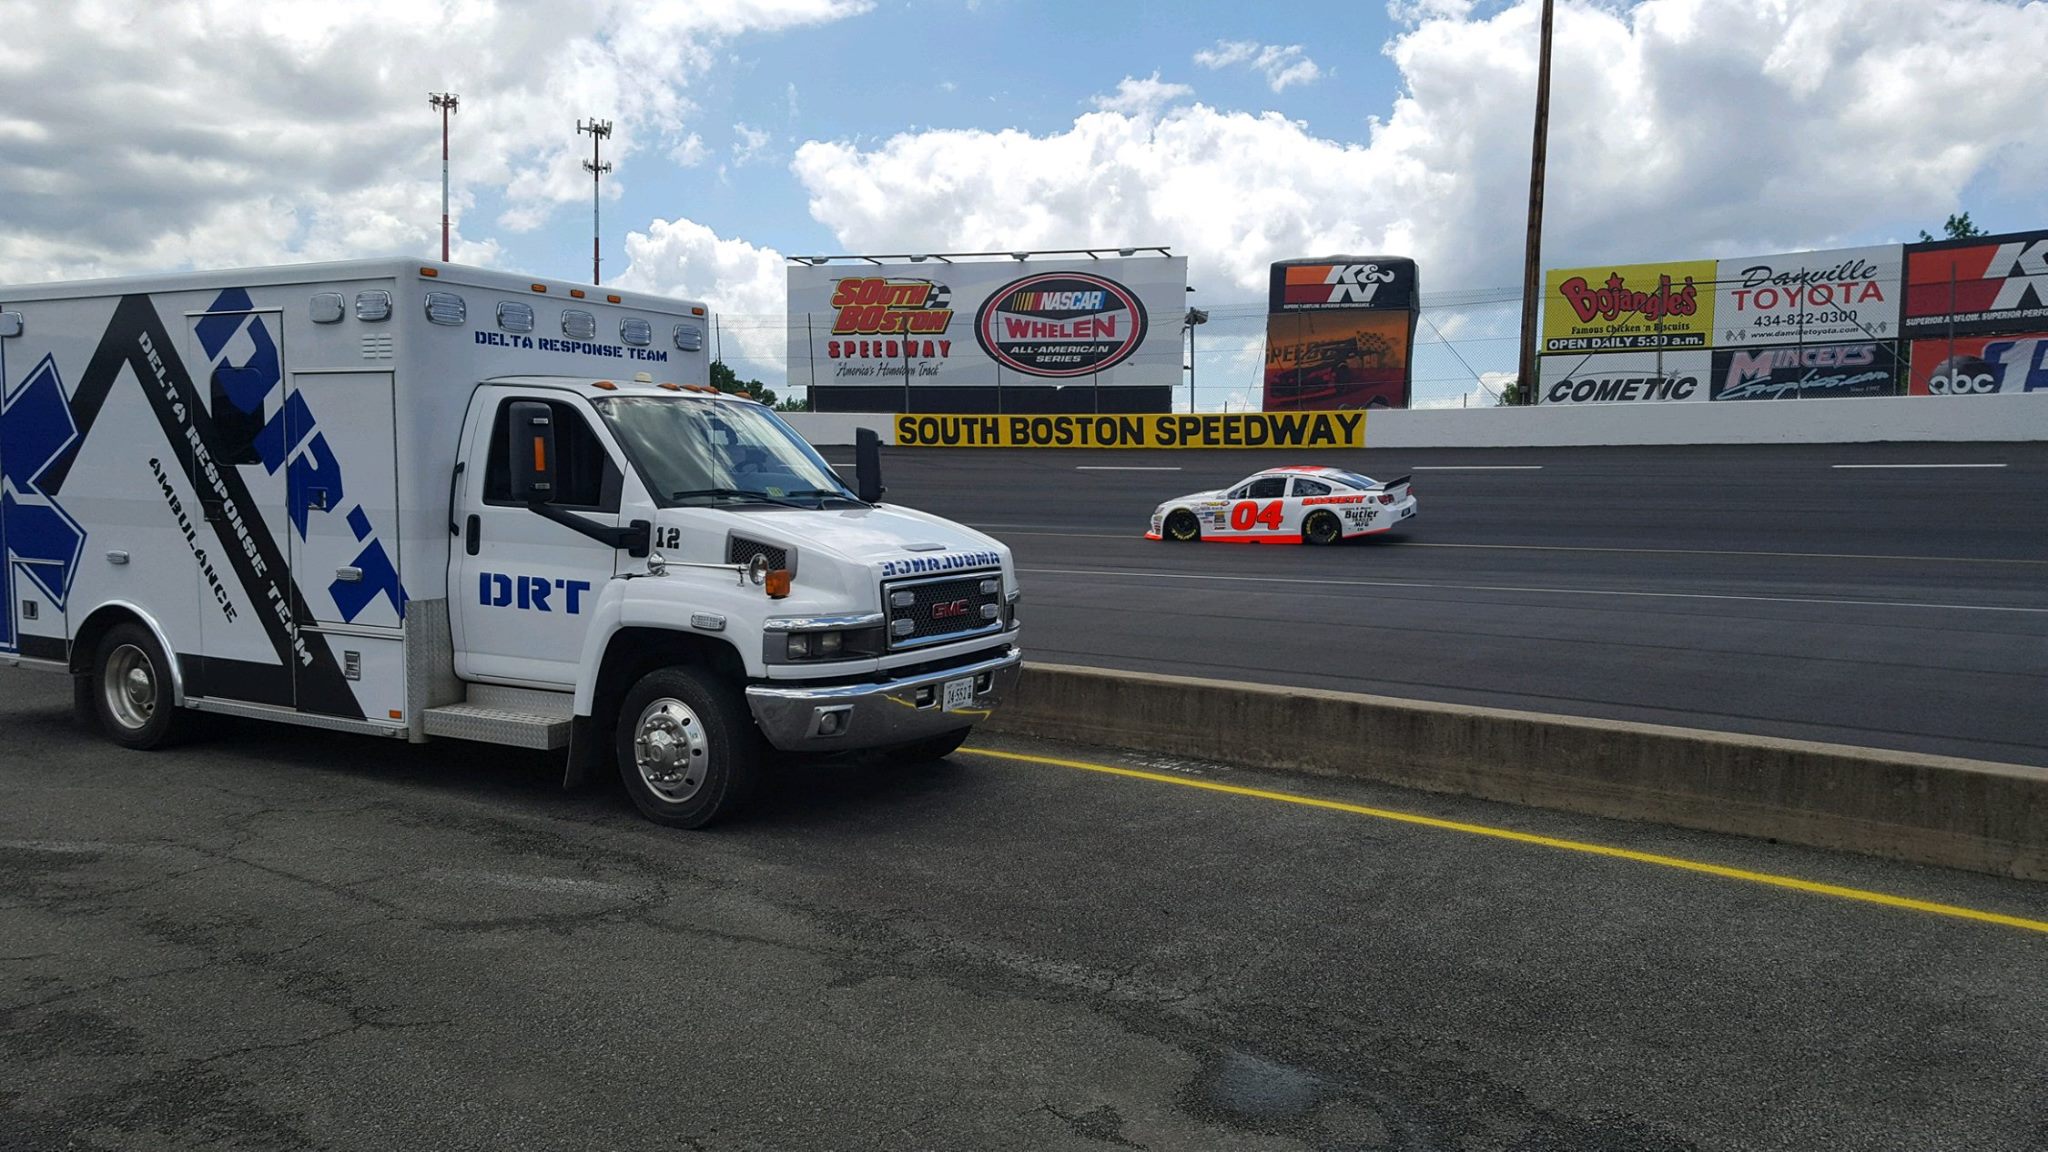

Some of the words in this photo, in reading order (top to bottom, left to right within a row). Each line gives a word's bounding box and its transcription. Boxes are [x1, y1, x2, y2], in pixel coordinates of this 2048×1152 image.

[1741, 259, 1878, 288] Danville
[1040, 291, 1103, 310] NASCAR
[1731, 281, 1884, 311] TOYOTA
[1005, 315, 1116, 338] WHELEN
[1754, 310, 1858, 327] 434-822-0300
[1981, 311, 2021, 321] SUPERIOR
[1571, 326, 1603, 335] Famous
[1606, 325, 1640, 334] Chicken
[1654, 323, 1690, 332] Bscuits
[475, 331, 533, 349] DELTA
[539, 338, 623, 358] RESPONSE
[627, 347, 668, 362] TEAM
[828, 340, 951, 358] SPEEDWAY
[1010, 345, 1109, 353] ALL-AMERICAN
[1549, 339, 1587, 349] OPEN
[1592, 336, 1632, 348] DAILY
[1638, 335, 1667, 346] 5:30
[1036, 355, 1081, 363] SERIES
[1549, 377, 1698, 402] COMETIC
[1928, 369, 1994, 394] abc
[900, 416, 1000, 445] SOUTH
[1010, 416, 1145, 445] BOSTON
[1155, 414, 1363, 445] SPEEDWAY
[138, 331, 186, 424] DELTA
[185, 423, 268, 579] RESPONSE
[267, 580, 315, 668] TEAM
[1230, 500, 1284, 531] 04
[1345, 509, 1379, 519] Butler
[149, 457, 238, 623] AMBULANCE
[656, 526, 681, 549] 12
[480, 572, 590, 615] DRT
[932, 599, 969, 619] GMC
